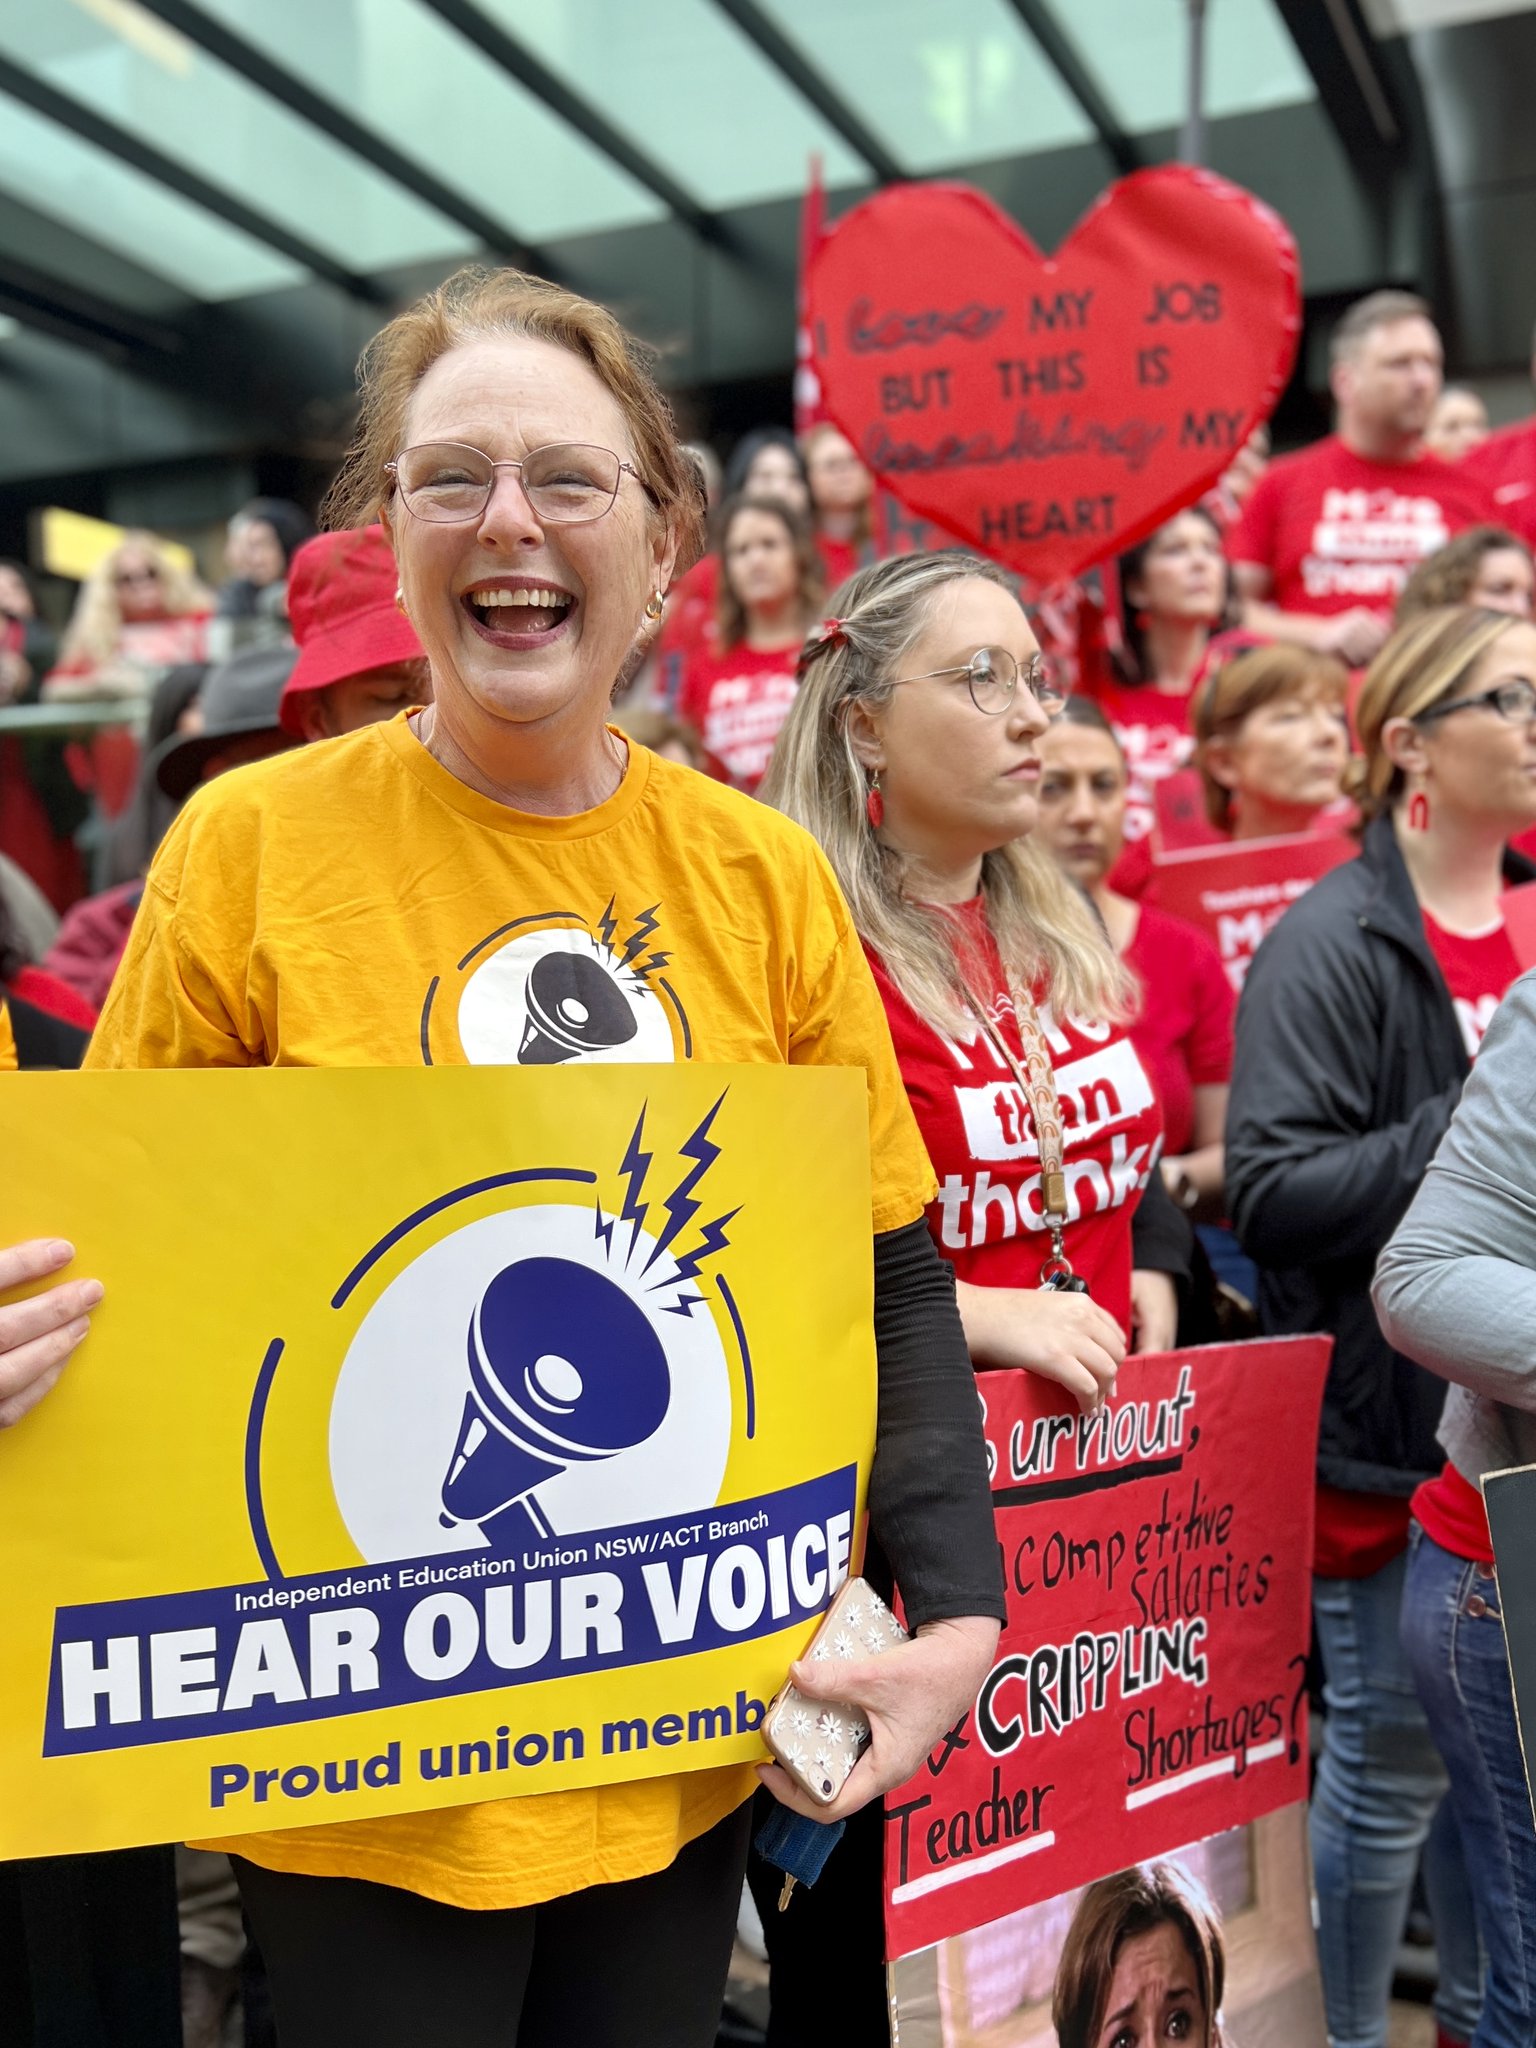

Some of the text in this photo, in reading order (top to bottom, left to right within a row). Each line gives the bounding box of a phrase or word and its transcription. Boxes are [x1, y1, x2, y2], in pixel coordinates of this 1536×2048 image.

[1029, 290, 1093, 333] MY
[1143, 281, 1223, 325] JOB
[881, 347, 1170, 415] BUT THIS IS
[1180, 410, 1245, 448] MY
[981, 496, 1118, 545] HEART
[978, 1365, 1200, 1481] urnout,
[235, 1510, 769, 1612] Independent Education Union NSW/ACT Branch
[1000, 1478, 1235, 1597] competitive
[60, 1510, 853, 1730] HEAR OUR VOICE
[976, 1616, 1209, 1757] CRIPPLING
[210, 1690, 766, 1809] Proud union memb
[885, 1766, 1056, 1886] Teacher
